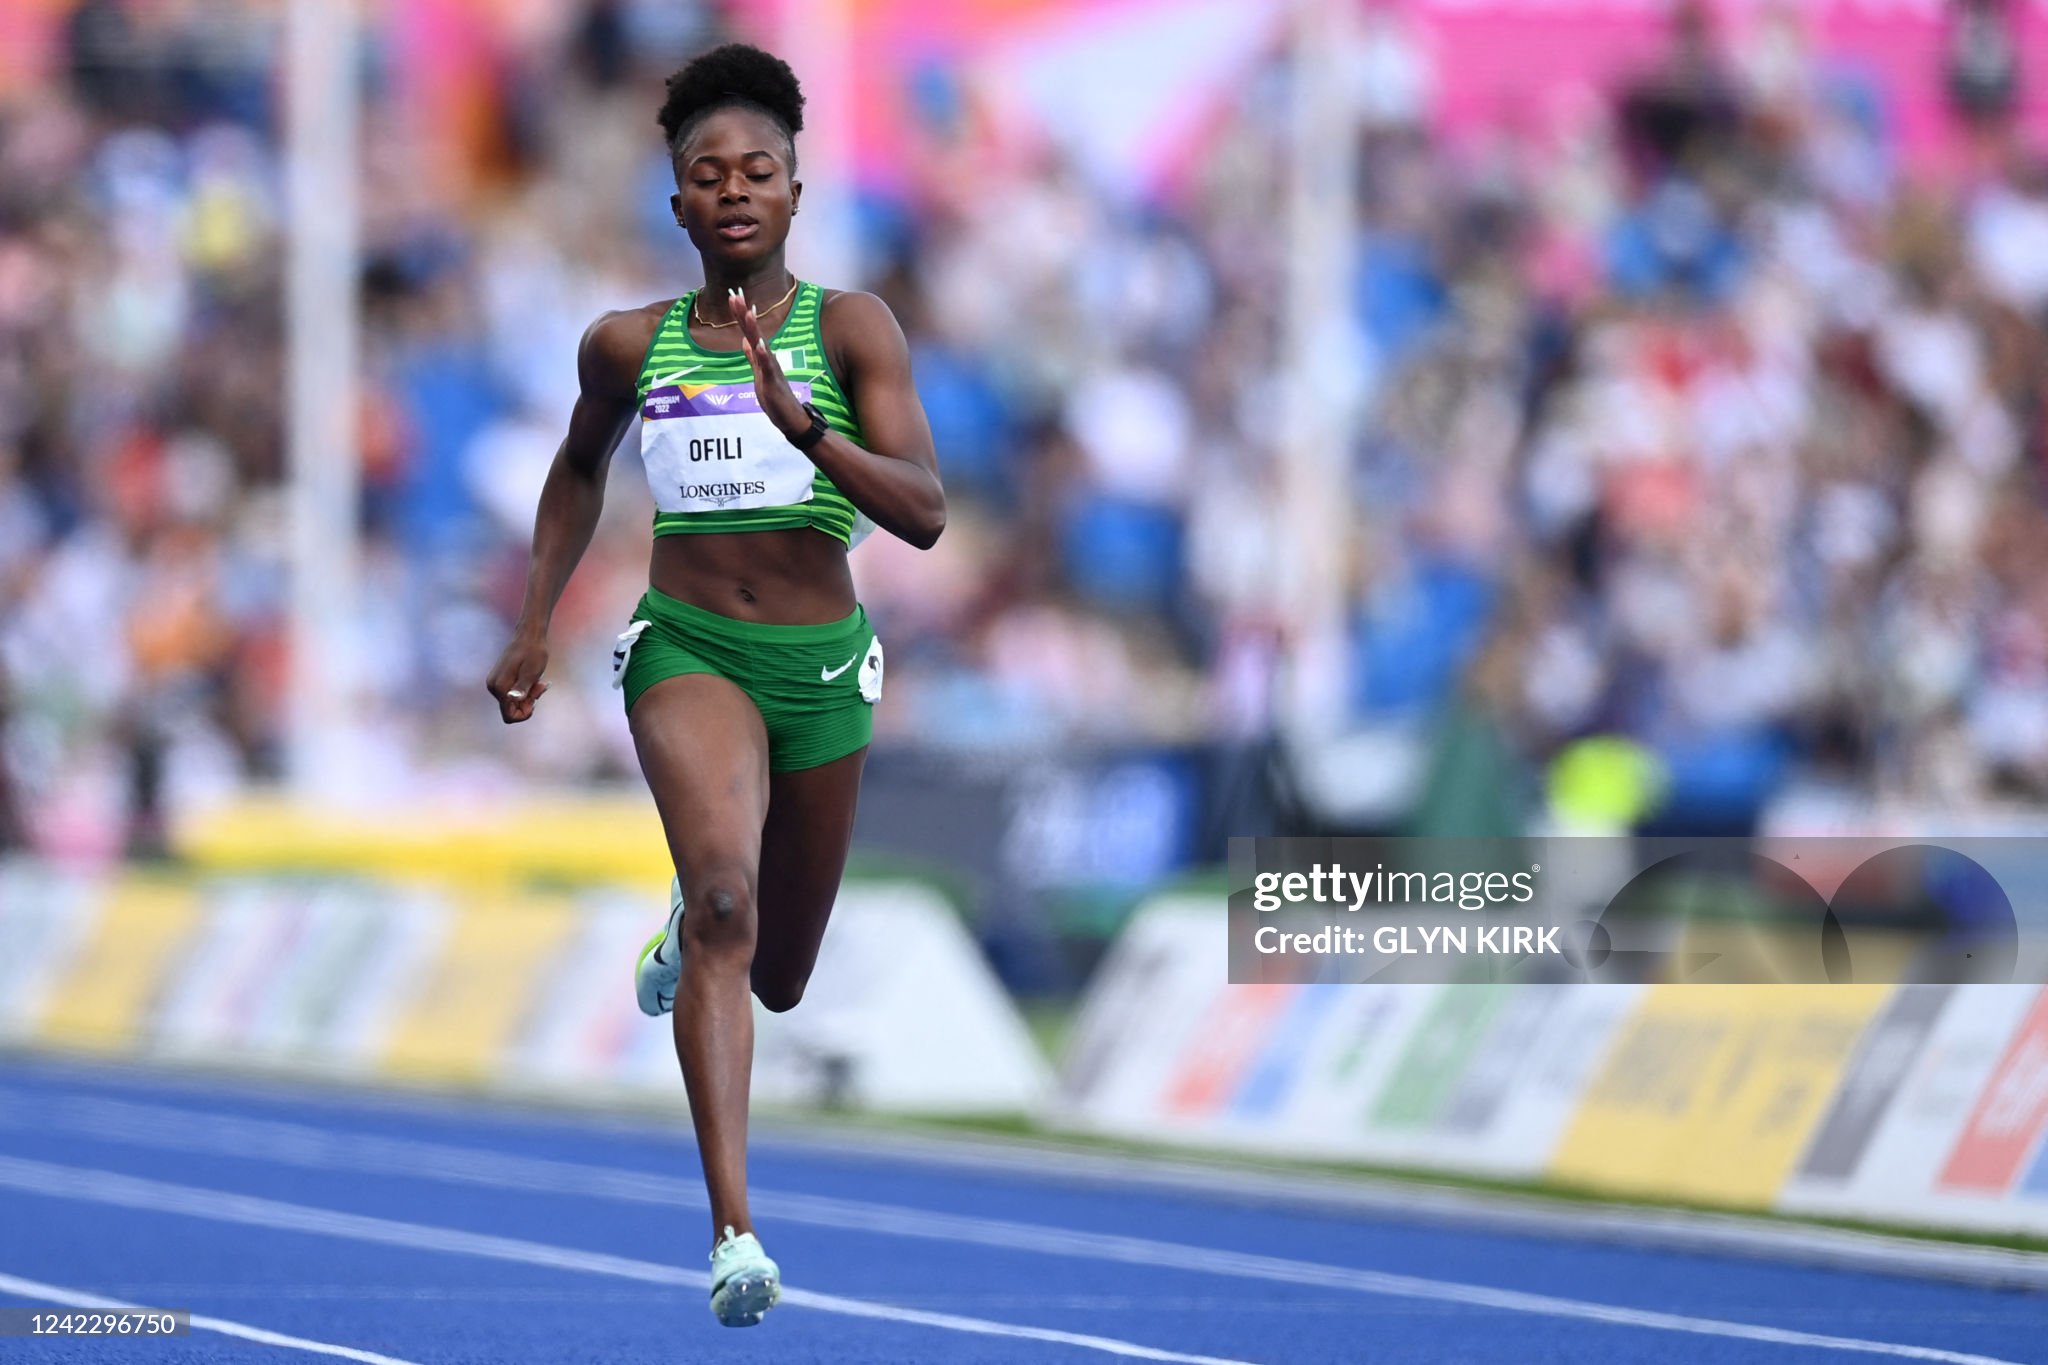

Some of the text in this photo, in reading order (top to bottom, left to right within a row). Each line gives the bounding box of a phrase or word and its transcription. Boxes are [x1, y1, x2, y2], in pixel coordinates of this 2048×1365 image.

[655, 404, 670, 414] 2022
[689, 437, 743, 462] OFILI
[679, 481, 766, 499] LONGINES
